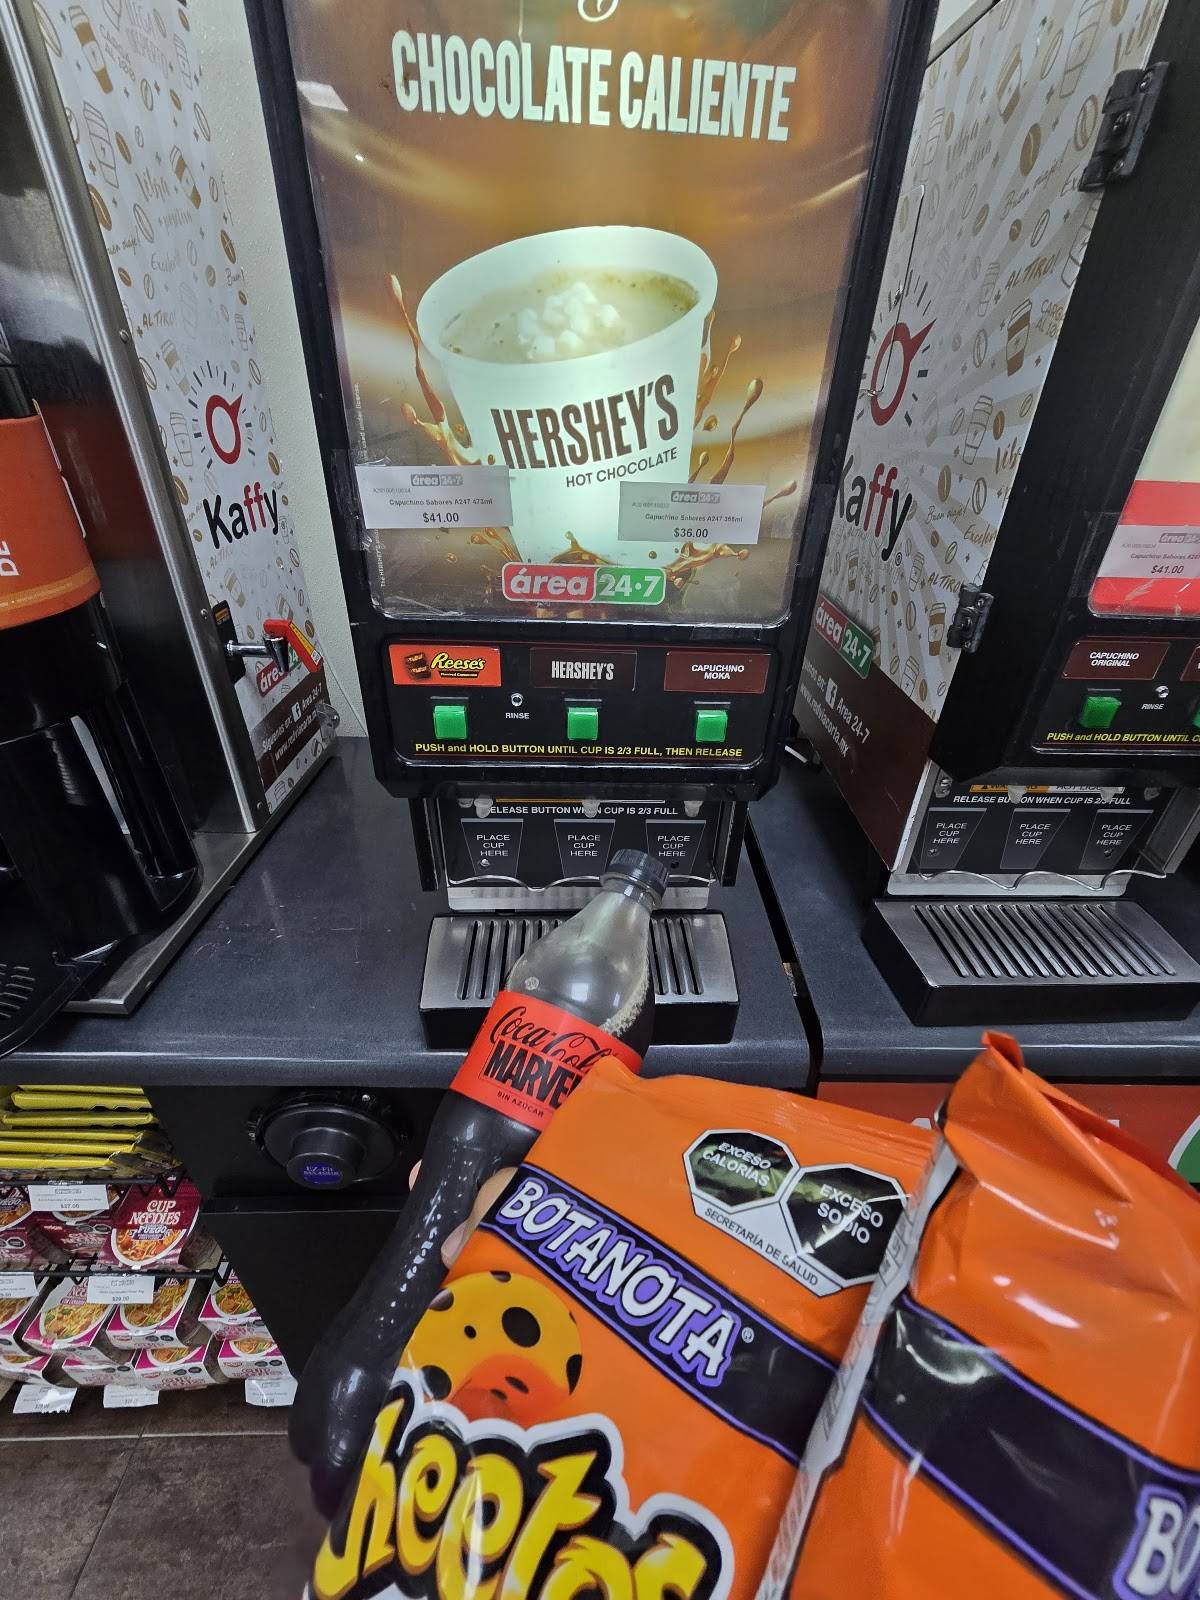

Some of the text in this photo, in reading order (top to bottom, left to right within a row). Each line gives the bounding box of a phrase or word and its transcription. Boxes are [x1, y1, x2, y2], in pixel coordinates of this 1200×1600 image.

[391, 29, 797, 141] CHOCOLATE CALIENTE
[491, 374, 679, 469] HERSHEY'S
[566, 447, 677, 488] HOT CHOCOLATE
[389, 499, 424, 507] Capuchino
[454, 498, 470, 506] A247
[203, 481, 279, 550] Kaffy
[422, 512, 460, 523] $41.00
[645, 513, 679, 521] Capuchino
[680, 514, 706, 522] Sabores
[707, 514, 722, 522] A247
[673, 528, 709, 538] $36.00
[1150, 565, 1185, 574] $41.00
[510, 567, 589, 596] área
[815, 602, 843, 643] área
[431, 652, 486, 670] Reese's
[1089, 652, 1140, 660] CAPUCHINO
[551, 660, 615, 681] HERSHEY'S
[691, 664, 745, 673] CAPUCHINO
[704, 672, 731, 680] MOKA
[836, 697, 852, 725] Area
[1141, 703, 1164, 711] RINSE
[505, 712, 530, 720] RINSE
[1046, 733, 1074, 741] PUSH
[1075, 733, 1092, 741] and
[1093, 734, 1121, 742] HOLD
[1122, 734, 1163, 742] BUTTON
[415, 743, 743, 757] PUSH and HOLD BUTTON UNTIL CUP IS 2/3 FULL, THEN RELEASE
[997, 796, 1036, 804] BUON
[489, 806, 529, 814] ELEASE
[531, 806, 571, 814] BUTTON
[604, 807, 624, 815] CUP
[626, 807, 636, 815] IS
[638, 807, 651, 815] 2/3
[653, 807, 679, 815] FULL
[480, 849, 509, 857] HERE
[570, 849, 598, 857] HERE
[497, 1090, 510, 1101] SIN
[718, 1142, 772, 1169] EXCESO
[702, 1150, 770, 1187] CALORÍAS
[147, 1200, 176, 1213] CUP
[819, 1183, 884, 1229] EXCESO
[128, 1212, 181, 1225] NOODLES
[704, 1207, 819, 1287] SECRETARÍA DE SALUD
[500, 1179, 736, 1378] BOTANOTA
